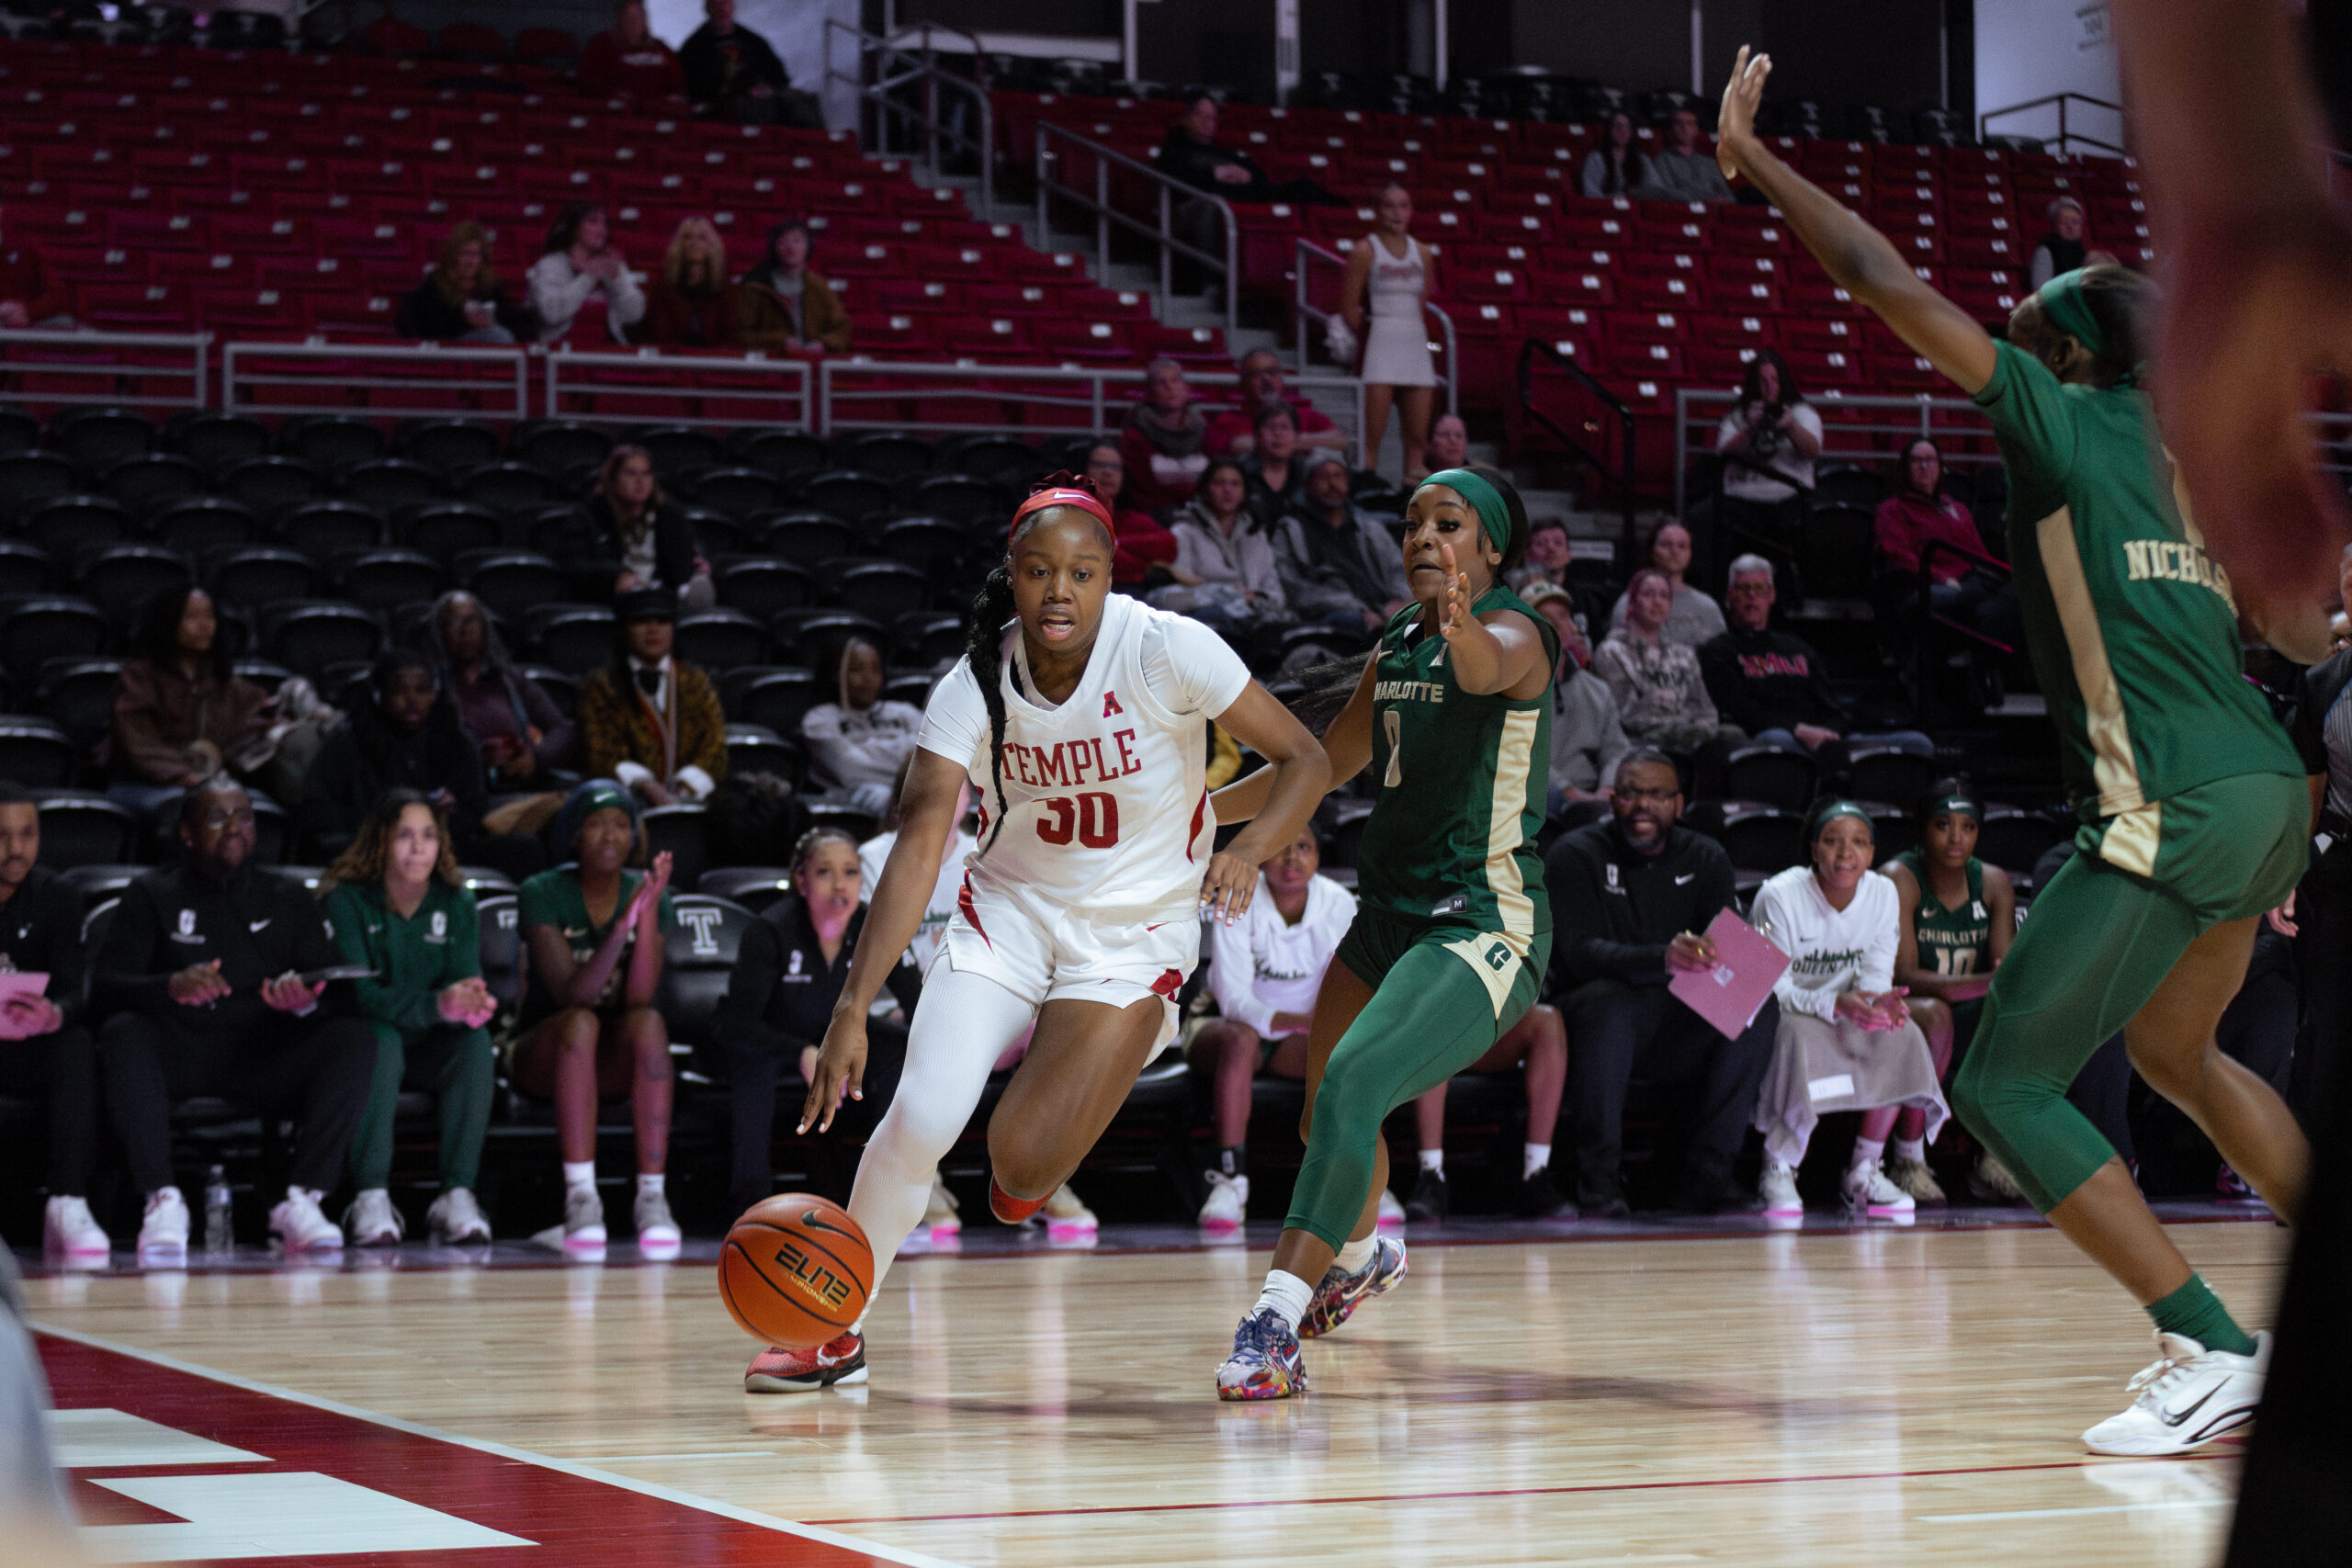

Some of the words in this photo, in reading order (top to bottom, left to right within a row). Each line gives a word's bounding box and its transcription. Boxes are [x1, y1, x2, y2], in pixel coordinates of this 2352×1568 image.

[2122, 539, 2240, 618] NICHO
[1102, 690, 1124, 718] A
[1373, 681, 1444, 703] HARLOTTE
[990, 728, 1142, 787] TEMPLE
[1031, 791, 1119, 849] 30
[1453, 899, 1463, 908] M
[1917, 926, 1989, 946] CHARLOTT
[775, 1242, 851, 1307] ELITE
